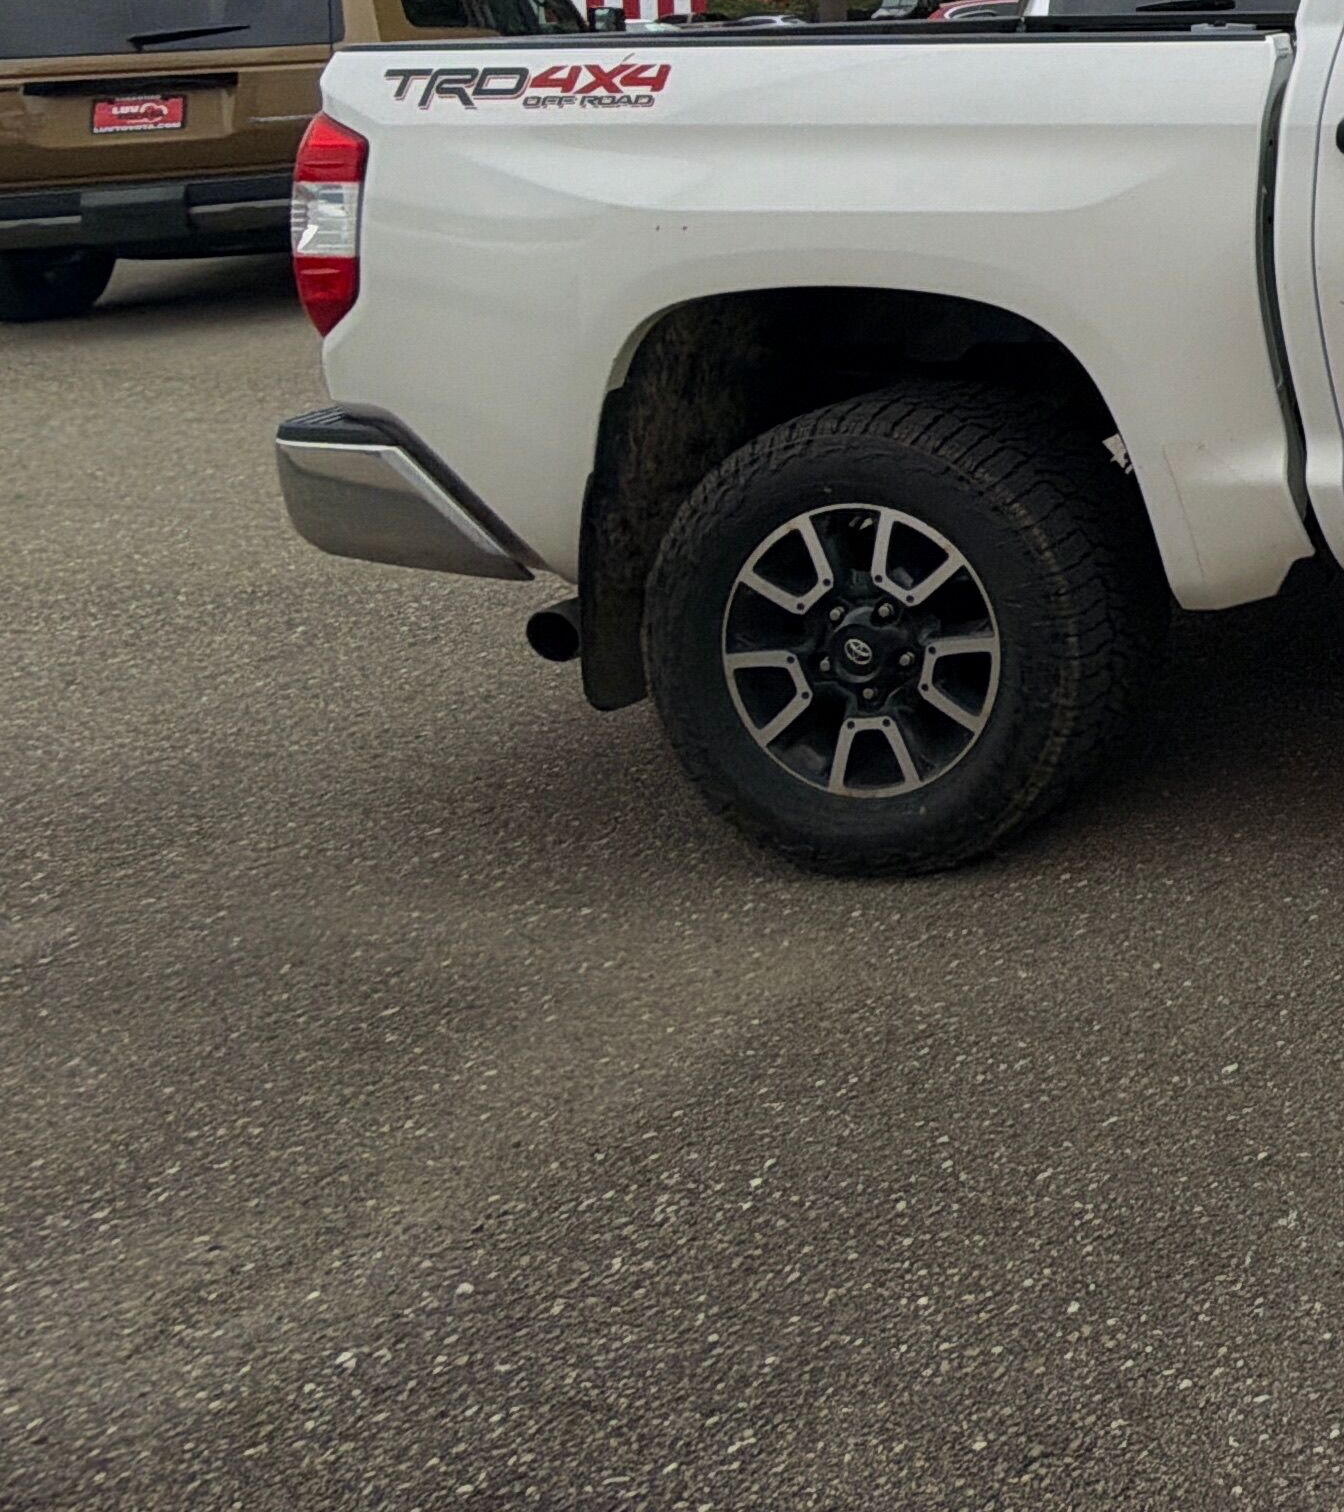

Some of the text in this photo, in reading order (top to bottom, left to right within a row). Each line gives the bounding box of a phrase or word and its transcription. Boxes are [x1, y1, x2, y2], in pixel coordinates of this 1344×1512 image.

[384, 67, 531, 110] TRD
[522, 93, 655, 108] OFF ROAD
